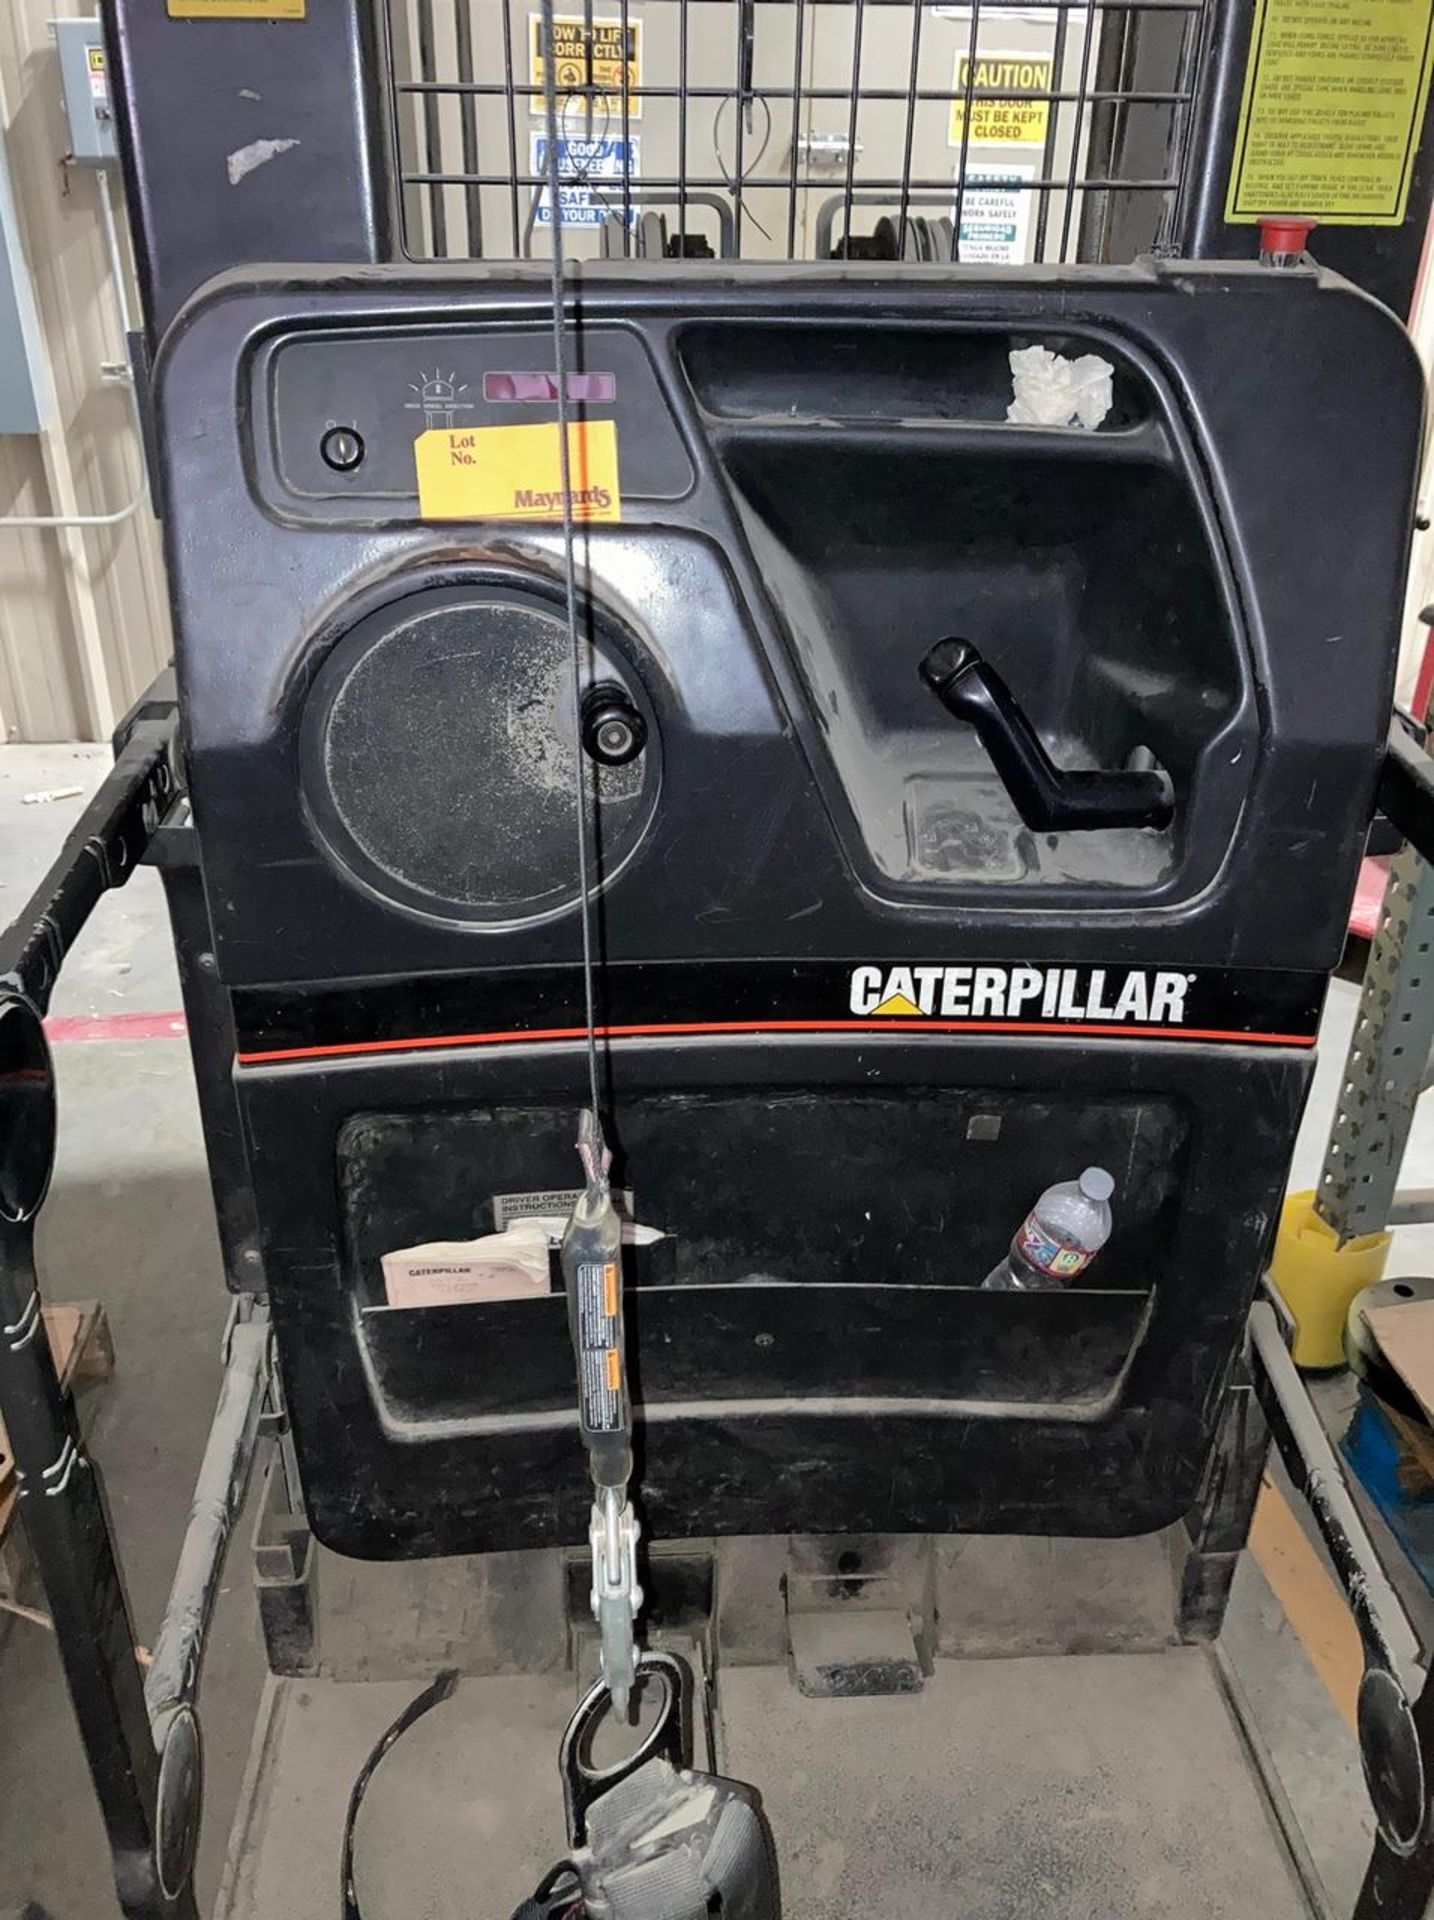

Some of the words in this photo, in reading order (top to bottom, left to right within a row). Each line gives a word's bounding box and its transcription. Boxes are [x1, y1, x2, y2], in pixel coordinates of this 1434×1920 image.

[600, 28, 630, 43] LIF
[961, 62, 1048, 88] CAUTION
[993, 110, 1010, 123] BE
[1013, 111, 1044, 124] KEPT
[974, 125, 1022, 139] CLOSED
[562, 208, 596, 222] YOUR
[450, 434, 476, 449] Lot
[451, 451, 477, 467] No.
[850, 966, 1188, 1023] CATERPILLAR
[502, 1194, 540, 1205] DRIVER
[408, 1267, 472, 1277] CATERPILLAR
